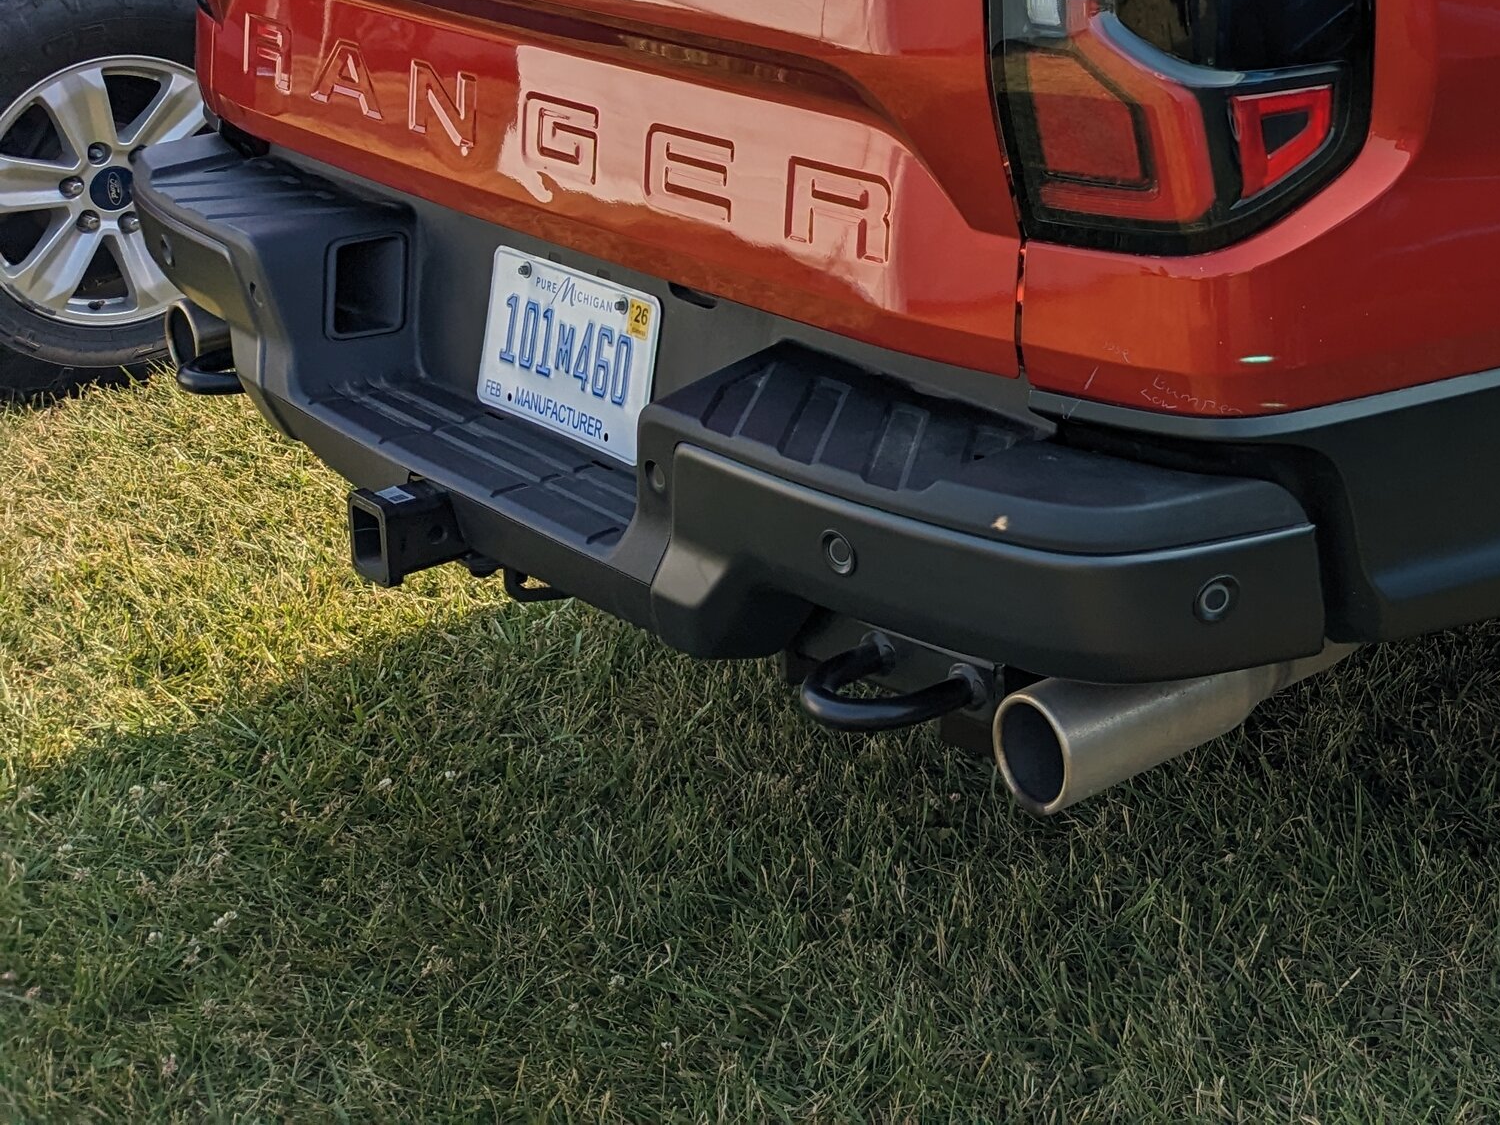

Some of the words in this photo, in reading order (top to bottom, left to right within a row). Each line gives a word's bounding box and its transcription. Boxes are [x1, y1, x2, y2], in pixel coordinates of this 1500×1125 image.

[243, 12, 892, 264] RANGER
[535, 276, 557, 293] PURE
[551, 276, 612, 313] MICHIGAN
[633, 304, 649, 326] 26
[500, 293, 632, 407] 101M460
[485, 379, 501, 398] FEB
[514, 386, 603, 442] MANUFACTURER
